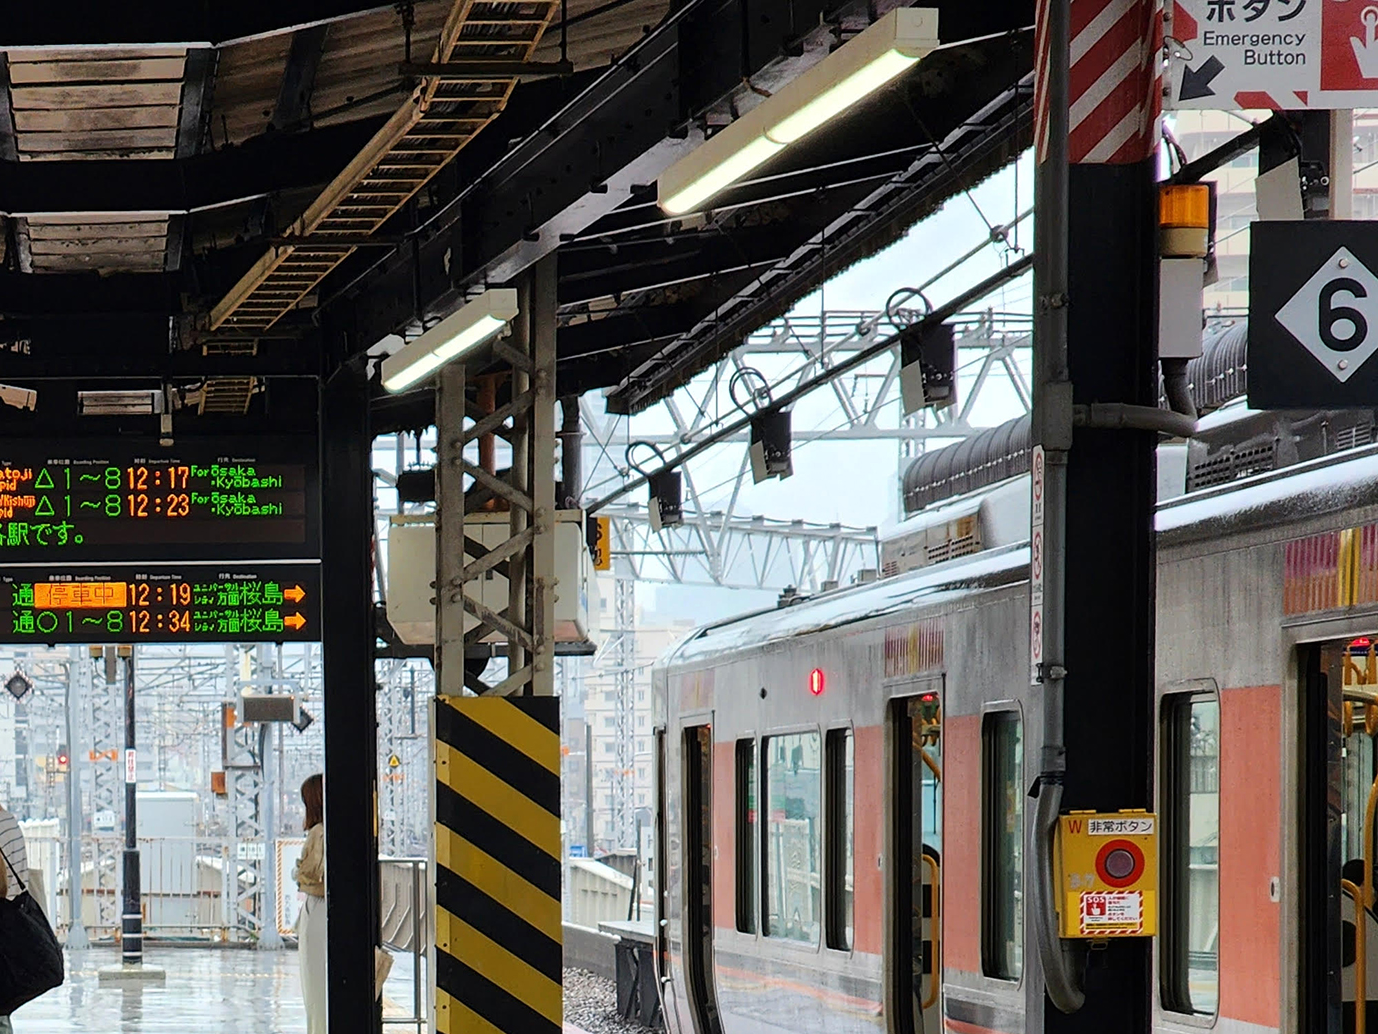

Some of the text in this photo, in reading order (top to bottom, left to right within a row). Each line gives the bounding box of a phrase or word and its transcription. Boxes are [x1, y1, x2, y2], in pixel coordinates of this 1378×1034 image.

[1206, 0, 1306, 23] ボタン
[1203, 31, 1306, 47] Emergency
[1244, 50, 1306, 66] Button
[1318, 277, 1368, 352] 6
[127, 466, 190, 490] 12:17
[191, 465, 209, 477] For
[127, 493, 190, 517] 12:23
[191, 492, 209, 504] For
[46, 583, 114, 606] 停車中
[129, 582, 191, 606] 12:19
[239, 581, 284, 606] 桜島
[129, 609, 191, 633] 12:34
[239, 608, 284, 633] 桜島
[1090, 820, 1153, 833] 非常ボタン
